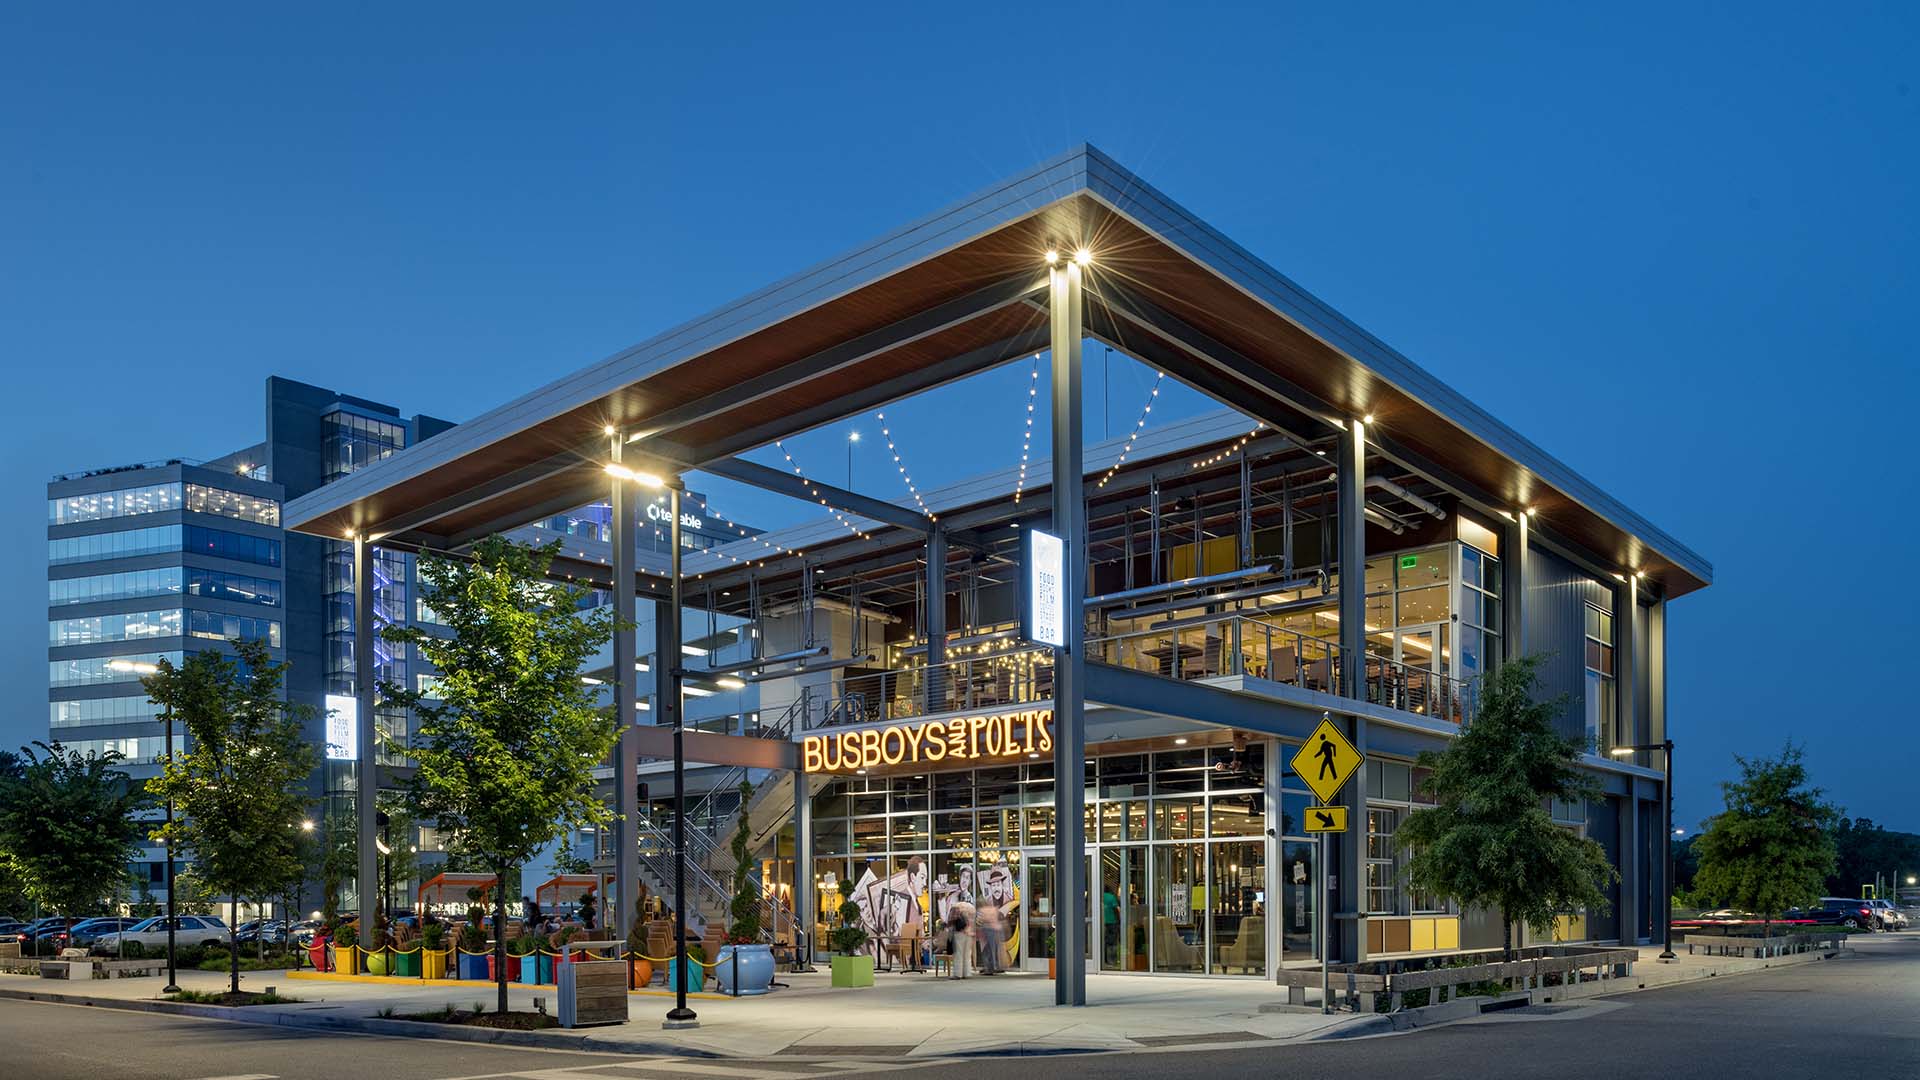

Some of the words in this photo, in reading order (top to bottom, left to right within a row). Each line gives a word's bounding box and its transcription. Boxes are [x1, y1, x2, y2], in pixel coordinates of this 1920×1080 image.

[660, 508, 702, 529] teable
[1039, 571, 1055, 586] FOOD
[1039, 591, 1055, 605] FILM
[1039, 625, 1055, 641] BAR
[803, 721, 946, 773] BUSBOYS
[949, 718, 967, 758] AND
[967, 710, 1053, 759] POETS
[335, 749, 349, 758] BAR
